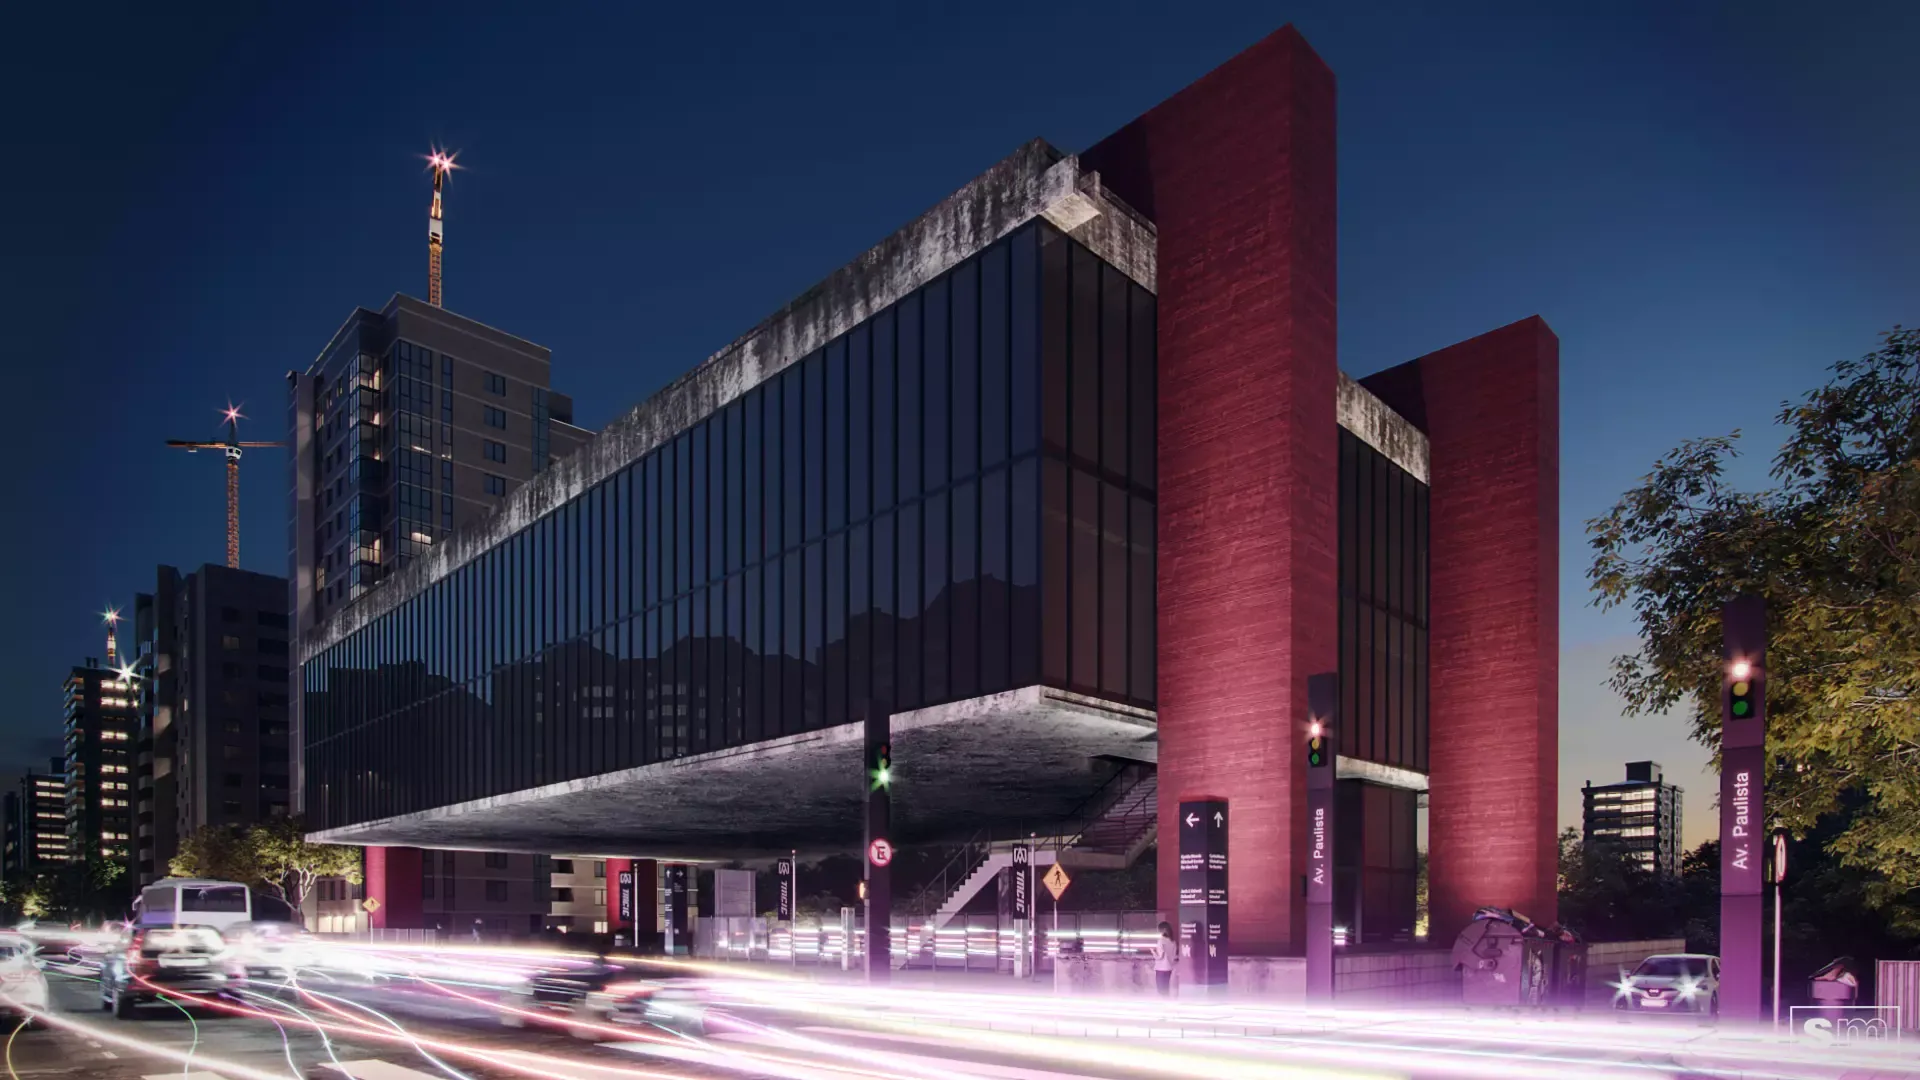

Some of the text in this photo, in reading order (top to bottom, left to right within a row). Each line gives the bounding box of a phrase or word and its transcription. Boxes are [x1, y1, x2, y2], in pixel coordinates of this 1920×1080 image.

[1313, 807, 1325, 885] Av. Paulista
[1732, 772, 1749, 870] Av. Paulista
